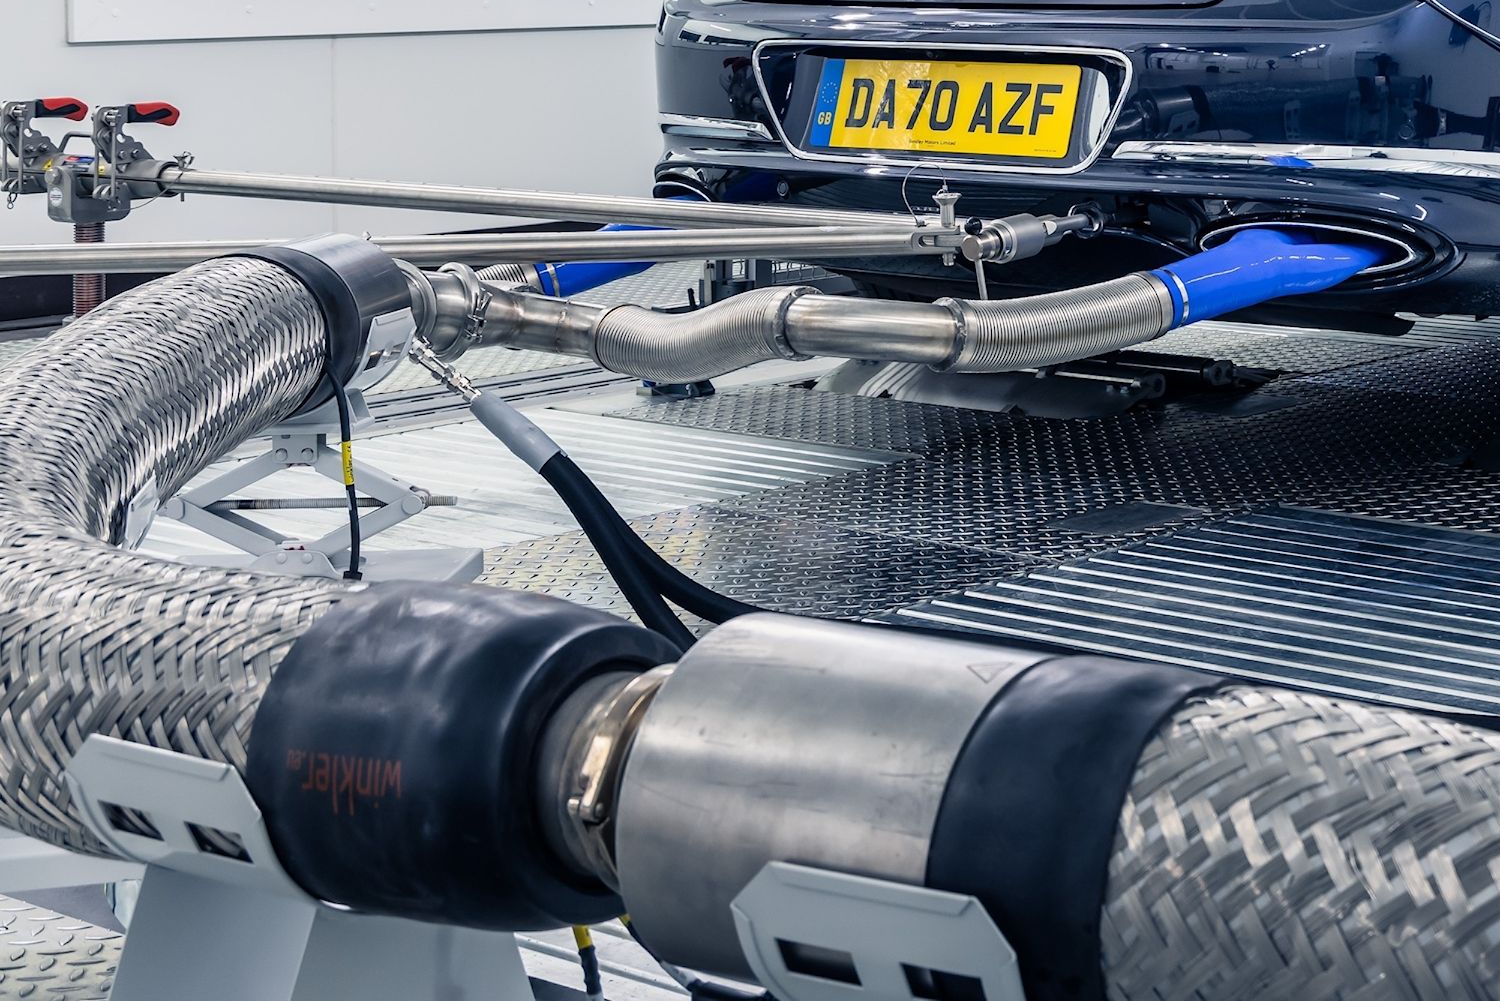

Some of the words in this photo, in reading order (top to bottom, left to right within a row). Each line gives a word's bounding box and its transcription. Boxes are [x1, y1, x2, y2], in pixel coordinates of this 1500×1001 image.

[817, 111, 832, 126] GB
[845, 78, 960, 131] DA70
[967, 82, 1063, 135] AZF
